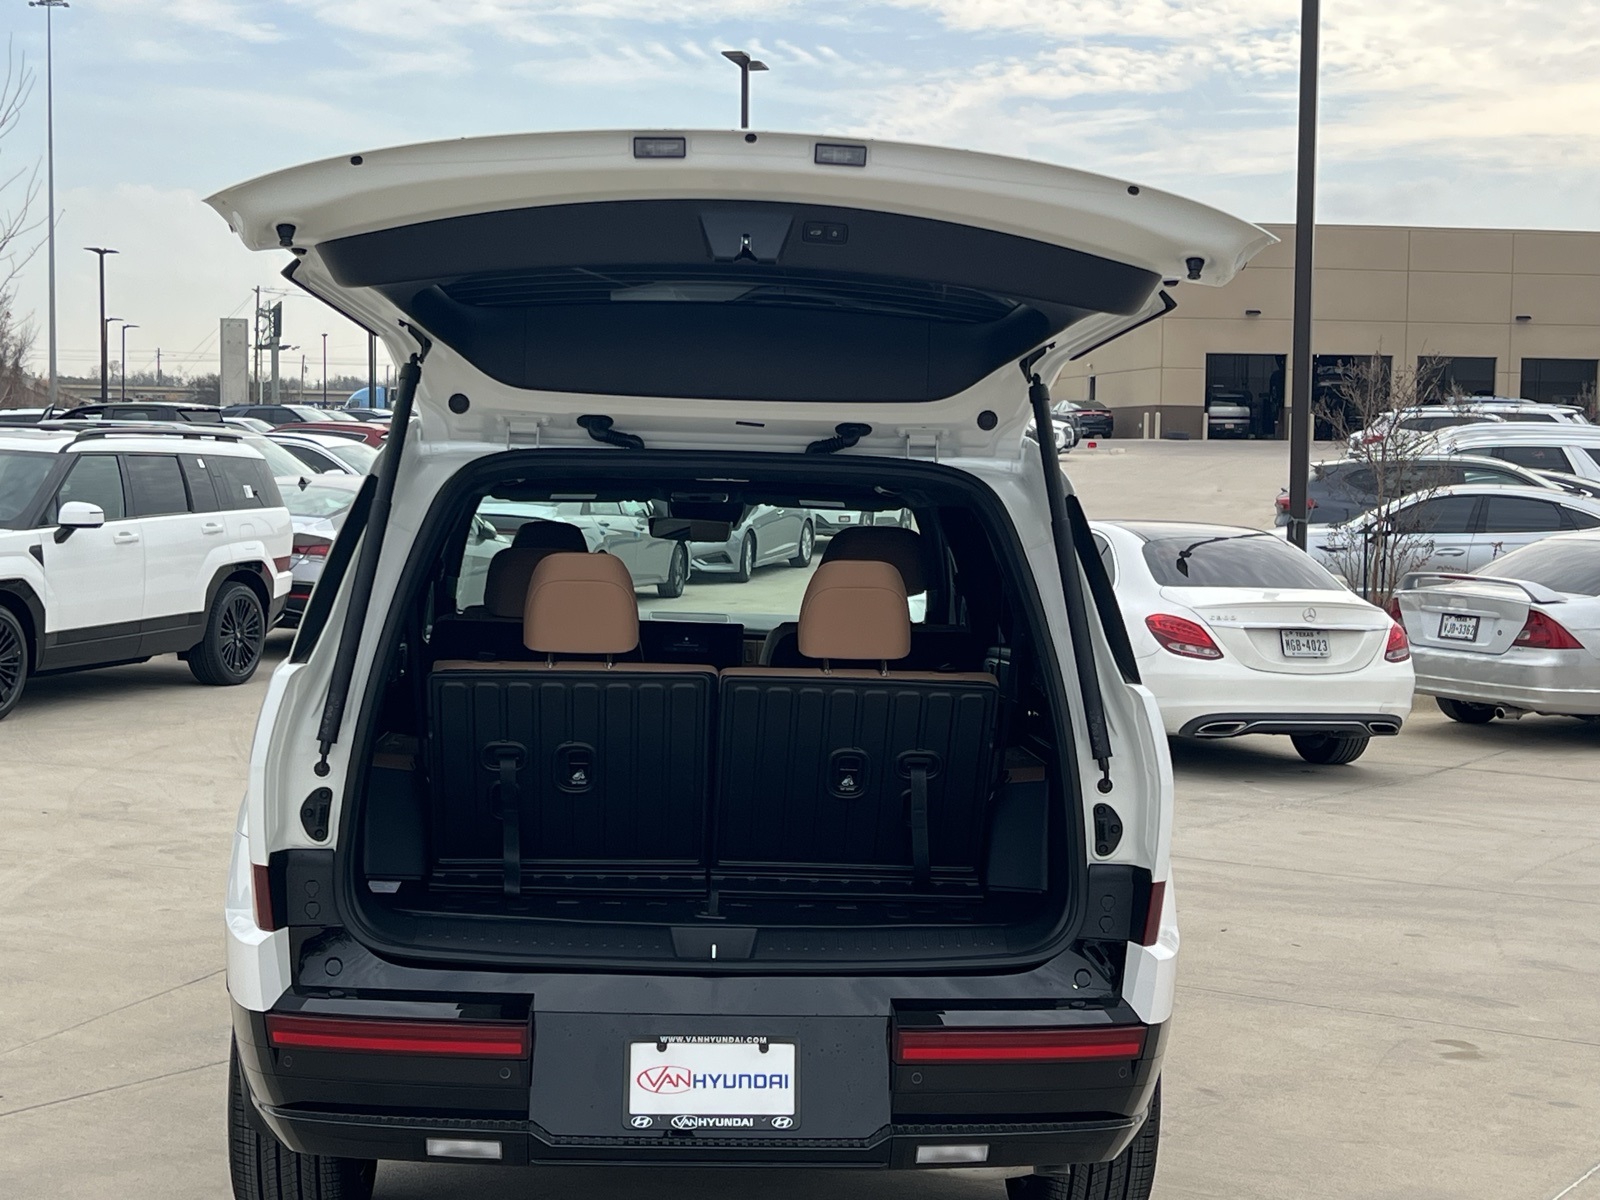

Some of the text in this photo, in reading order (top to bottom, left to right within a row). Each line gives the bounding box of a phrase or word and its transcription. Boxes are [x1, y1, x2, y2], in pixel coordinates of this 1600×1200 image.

[659, 1036, 767, 1044] WWW.VANHYUNDAI.COM
[644, 1066, 789, 1094] VAN HYUNDAI
[698, 1118, 754, 1127] HYUNDAI
